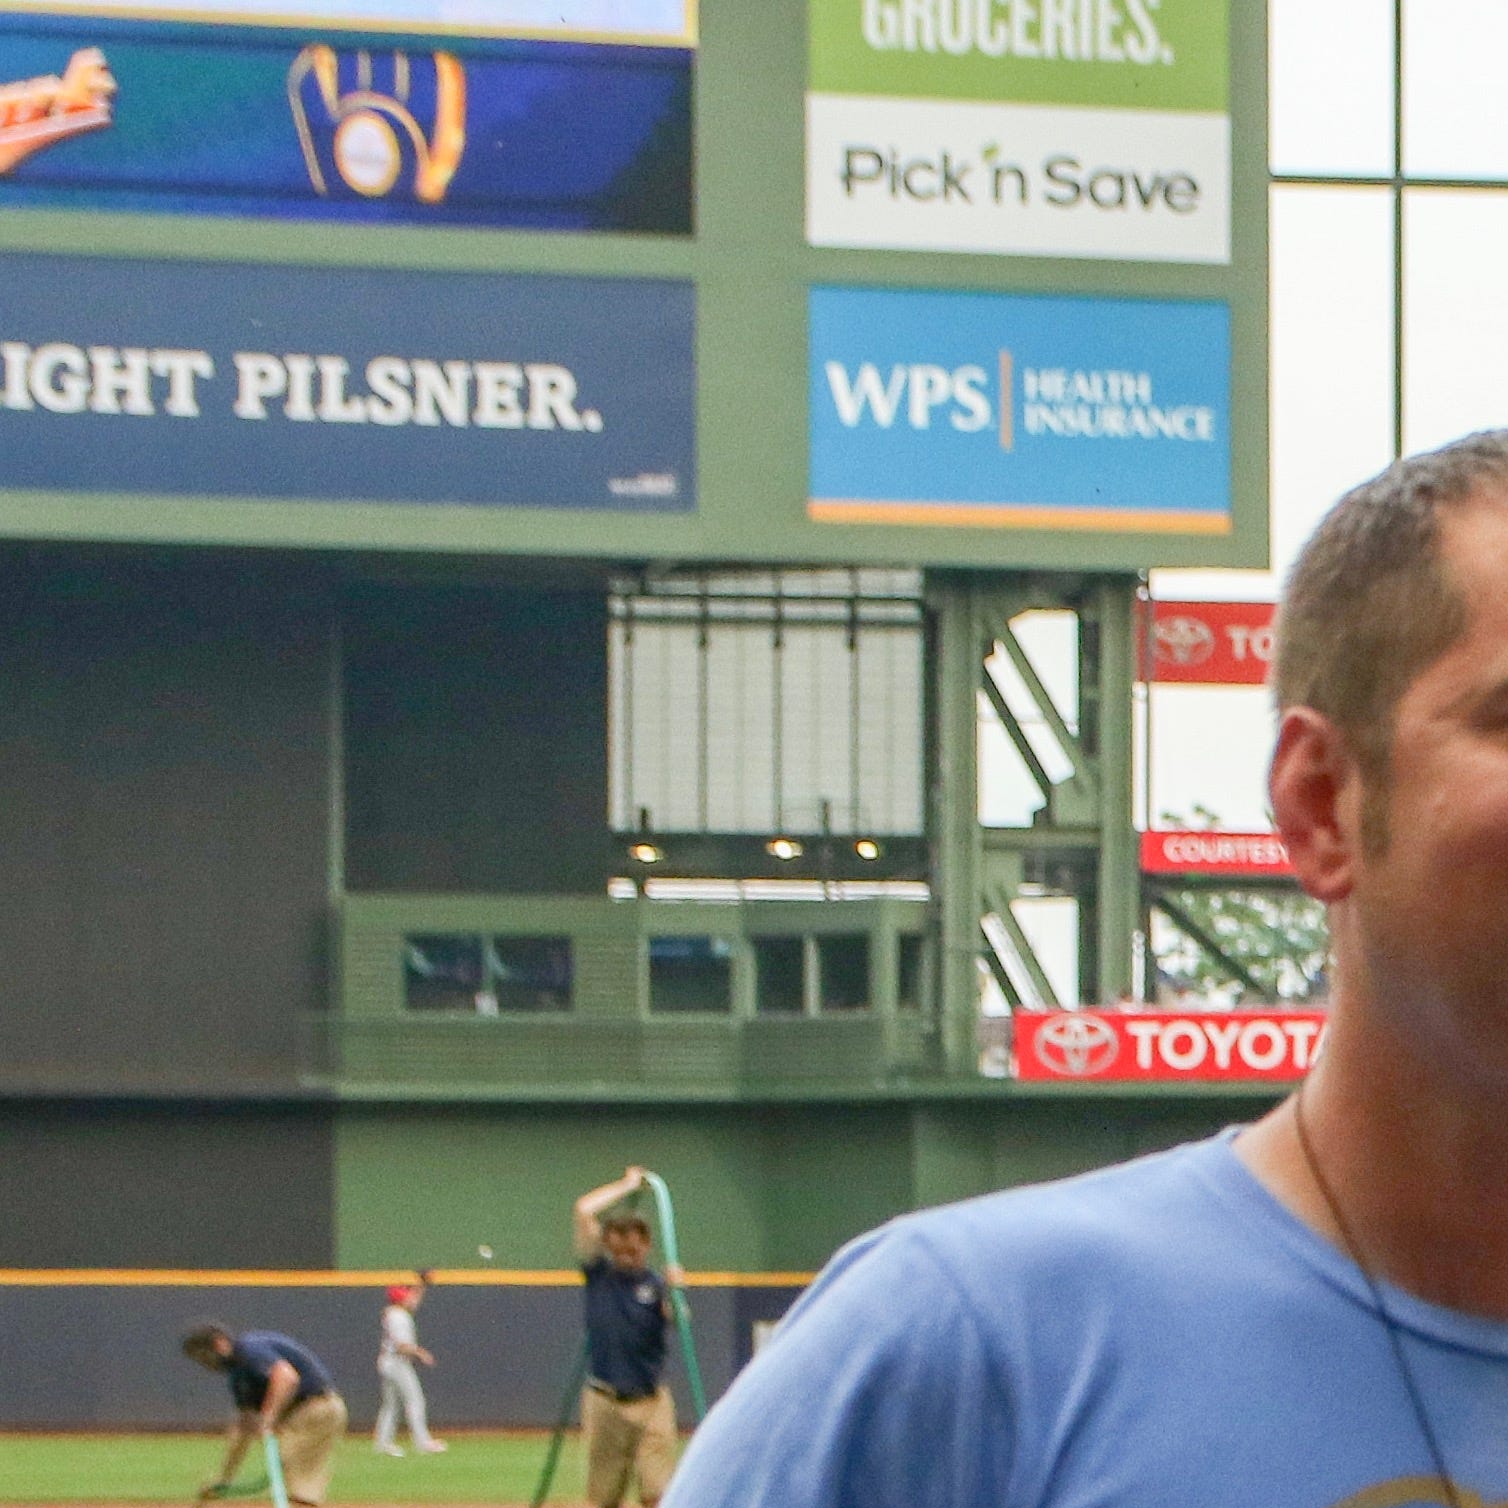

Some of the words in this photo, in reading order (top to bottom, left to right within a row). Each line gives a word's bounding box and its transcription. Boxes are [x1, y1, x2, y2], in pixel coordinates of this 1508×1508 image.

[863, 0, 1175, 65] GROCERIES.
[841, 149, 972, 206] Pick
[1045, 157, 1200, 214] Save
[0, 341, 216, 417] IGHT
[233, 350, 603, 433] PILSNER.
[825, 360, 992, 433] WPS
[1023, 367, 1154, 406] HEALTH
[1023, 405, 1215, 443] INSURANCE
